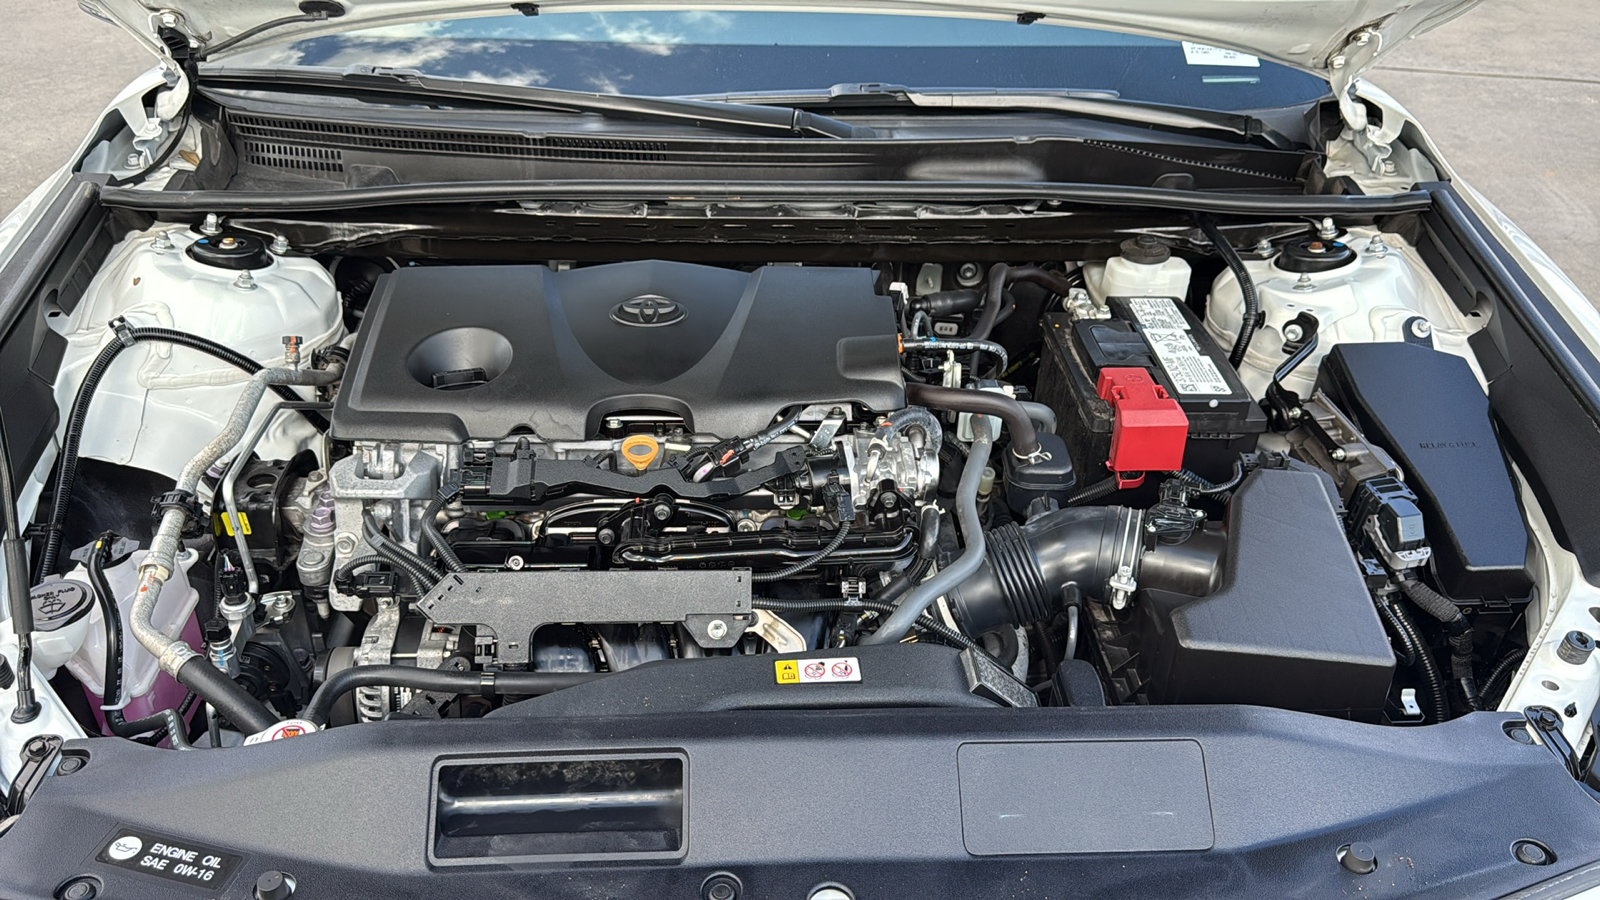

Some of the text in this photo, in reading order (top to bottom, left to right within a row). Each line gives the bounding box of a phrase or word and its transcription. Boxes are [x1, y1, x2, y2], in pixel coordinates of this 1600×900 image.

[140, 855, 215, 881] SAE 0W-16
[150, 843, 222, 868] ENGINE OIL
